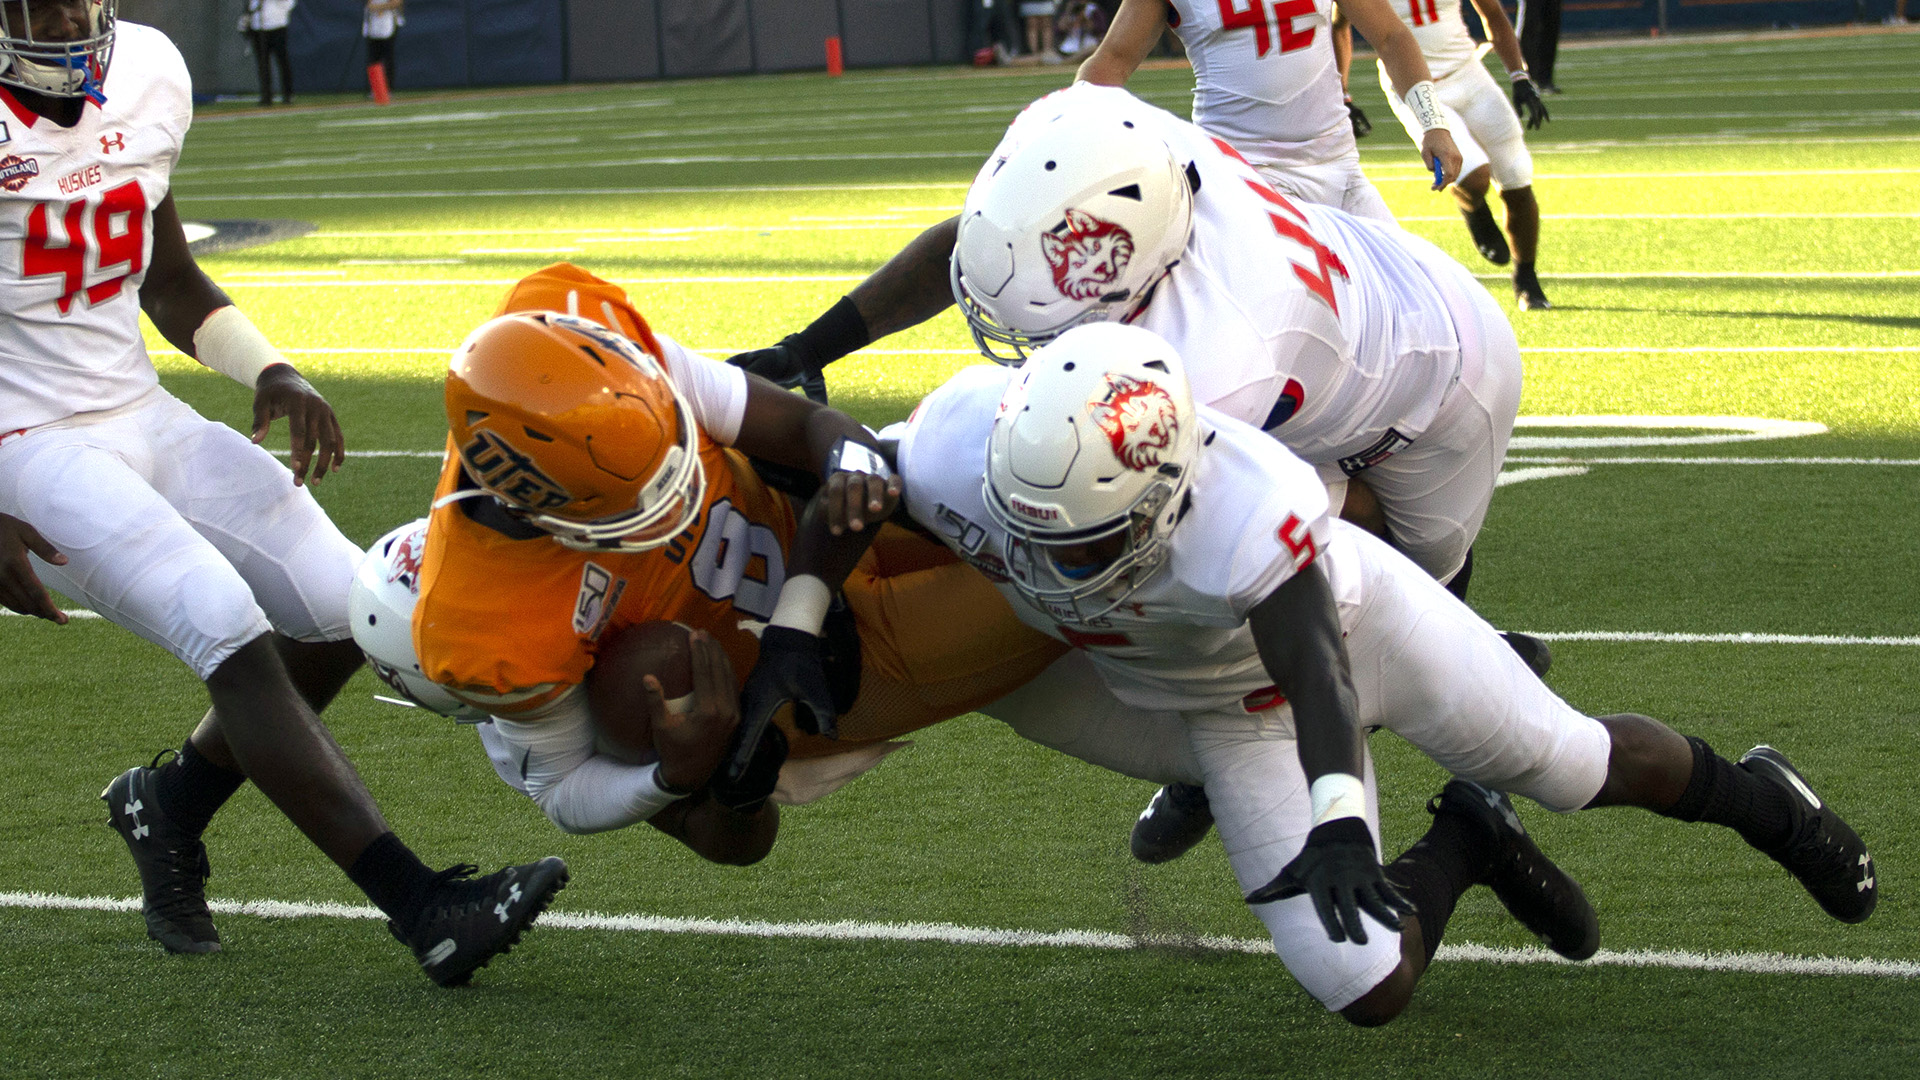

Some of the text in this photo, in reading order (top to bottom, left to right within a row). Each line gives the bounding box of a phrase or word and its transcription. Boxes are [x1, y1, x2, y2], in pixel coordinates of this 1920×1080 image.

[57, 164, 102, 196] HUSKIES
[20, 177, 148, 318] 49
[1275, 511, 1318, 573] 5
